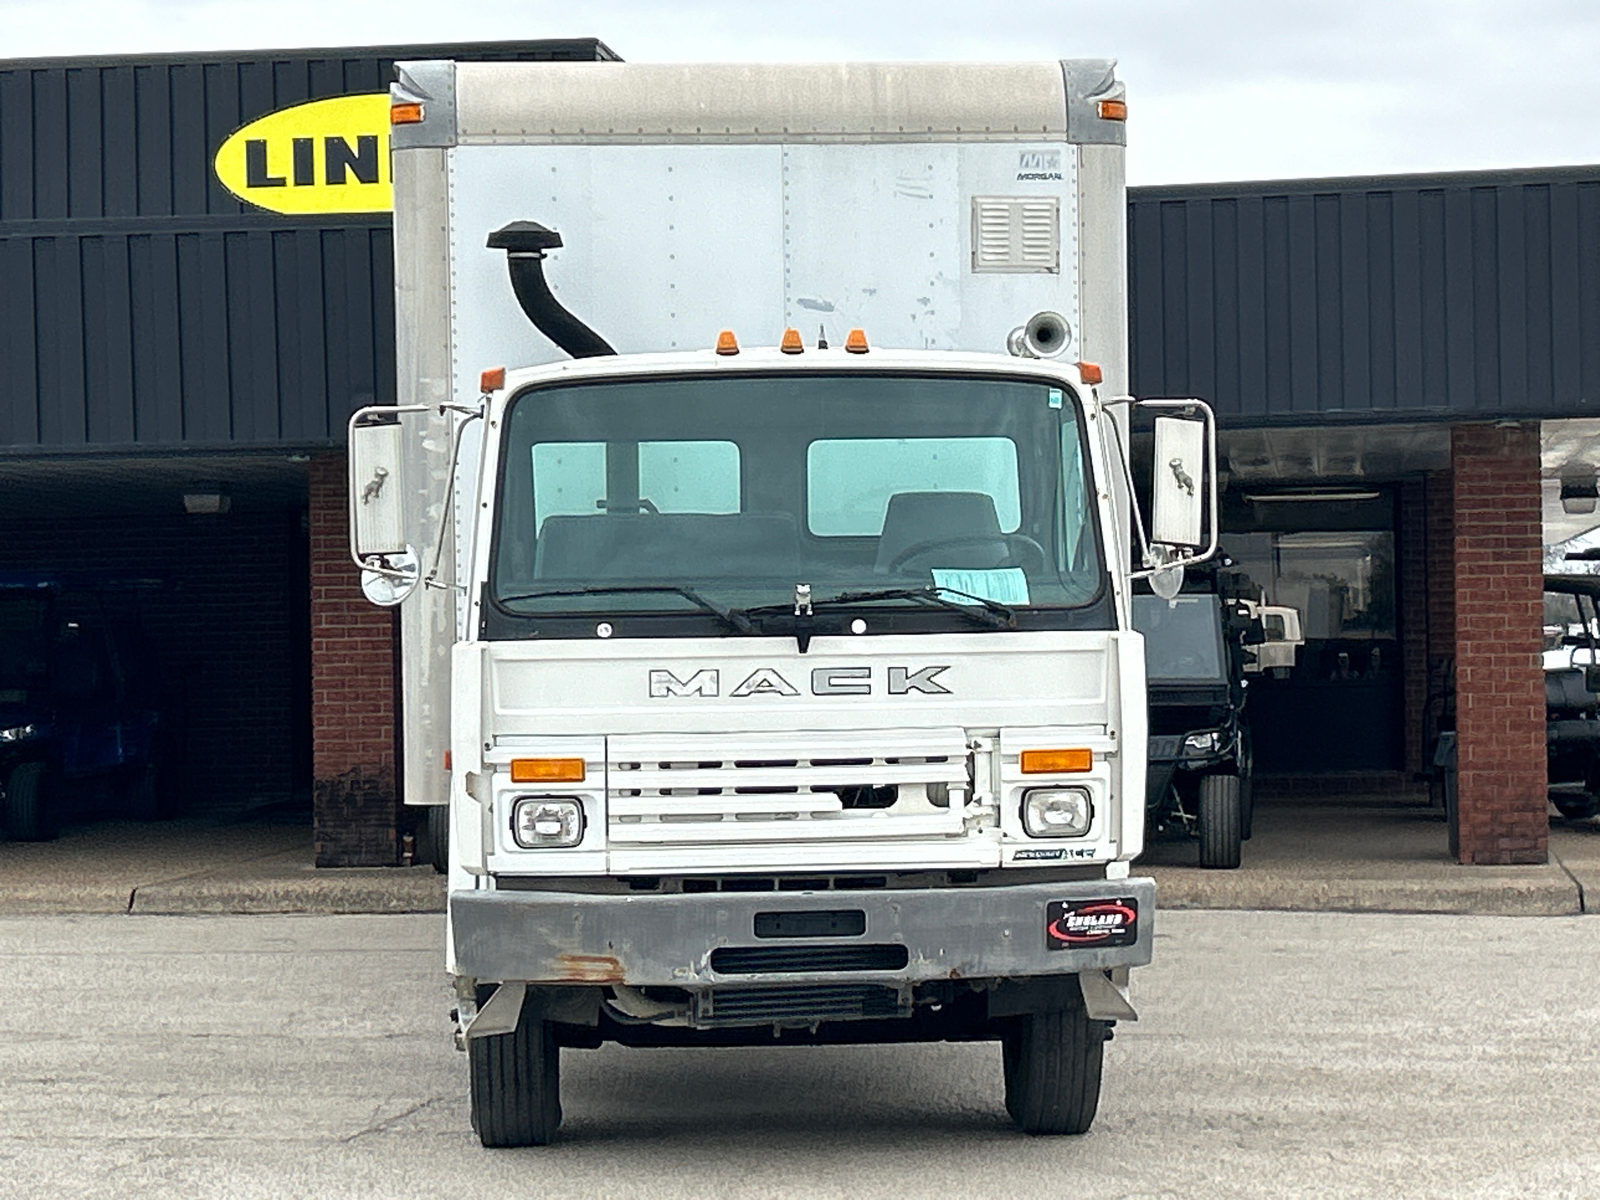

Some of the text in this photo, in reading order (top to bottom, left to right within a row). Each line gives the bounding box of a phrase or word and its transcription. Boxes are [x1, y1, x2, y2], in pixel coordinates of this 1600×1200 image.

[245, 135, 392, 188] LIN
[1017, 172, 1063, 181] MORGAN
[649, 666, 954, 698] MACK
[1066, 913, 1123, 927] ENGLAND
